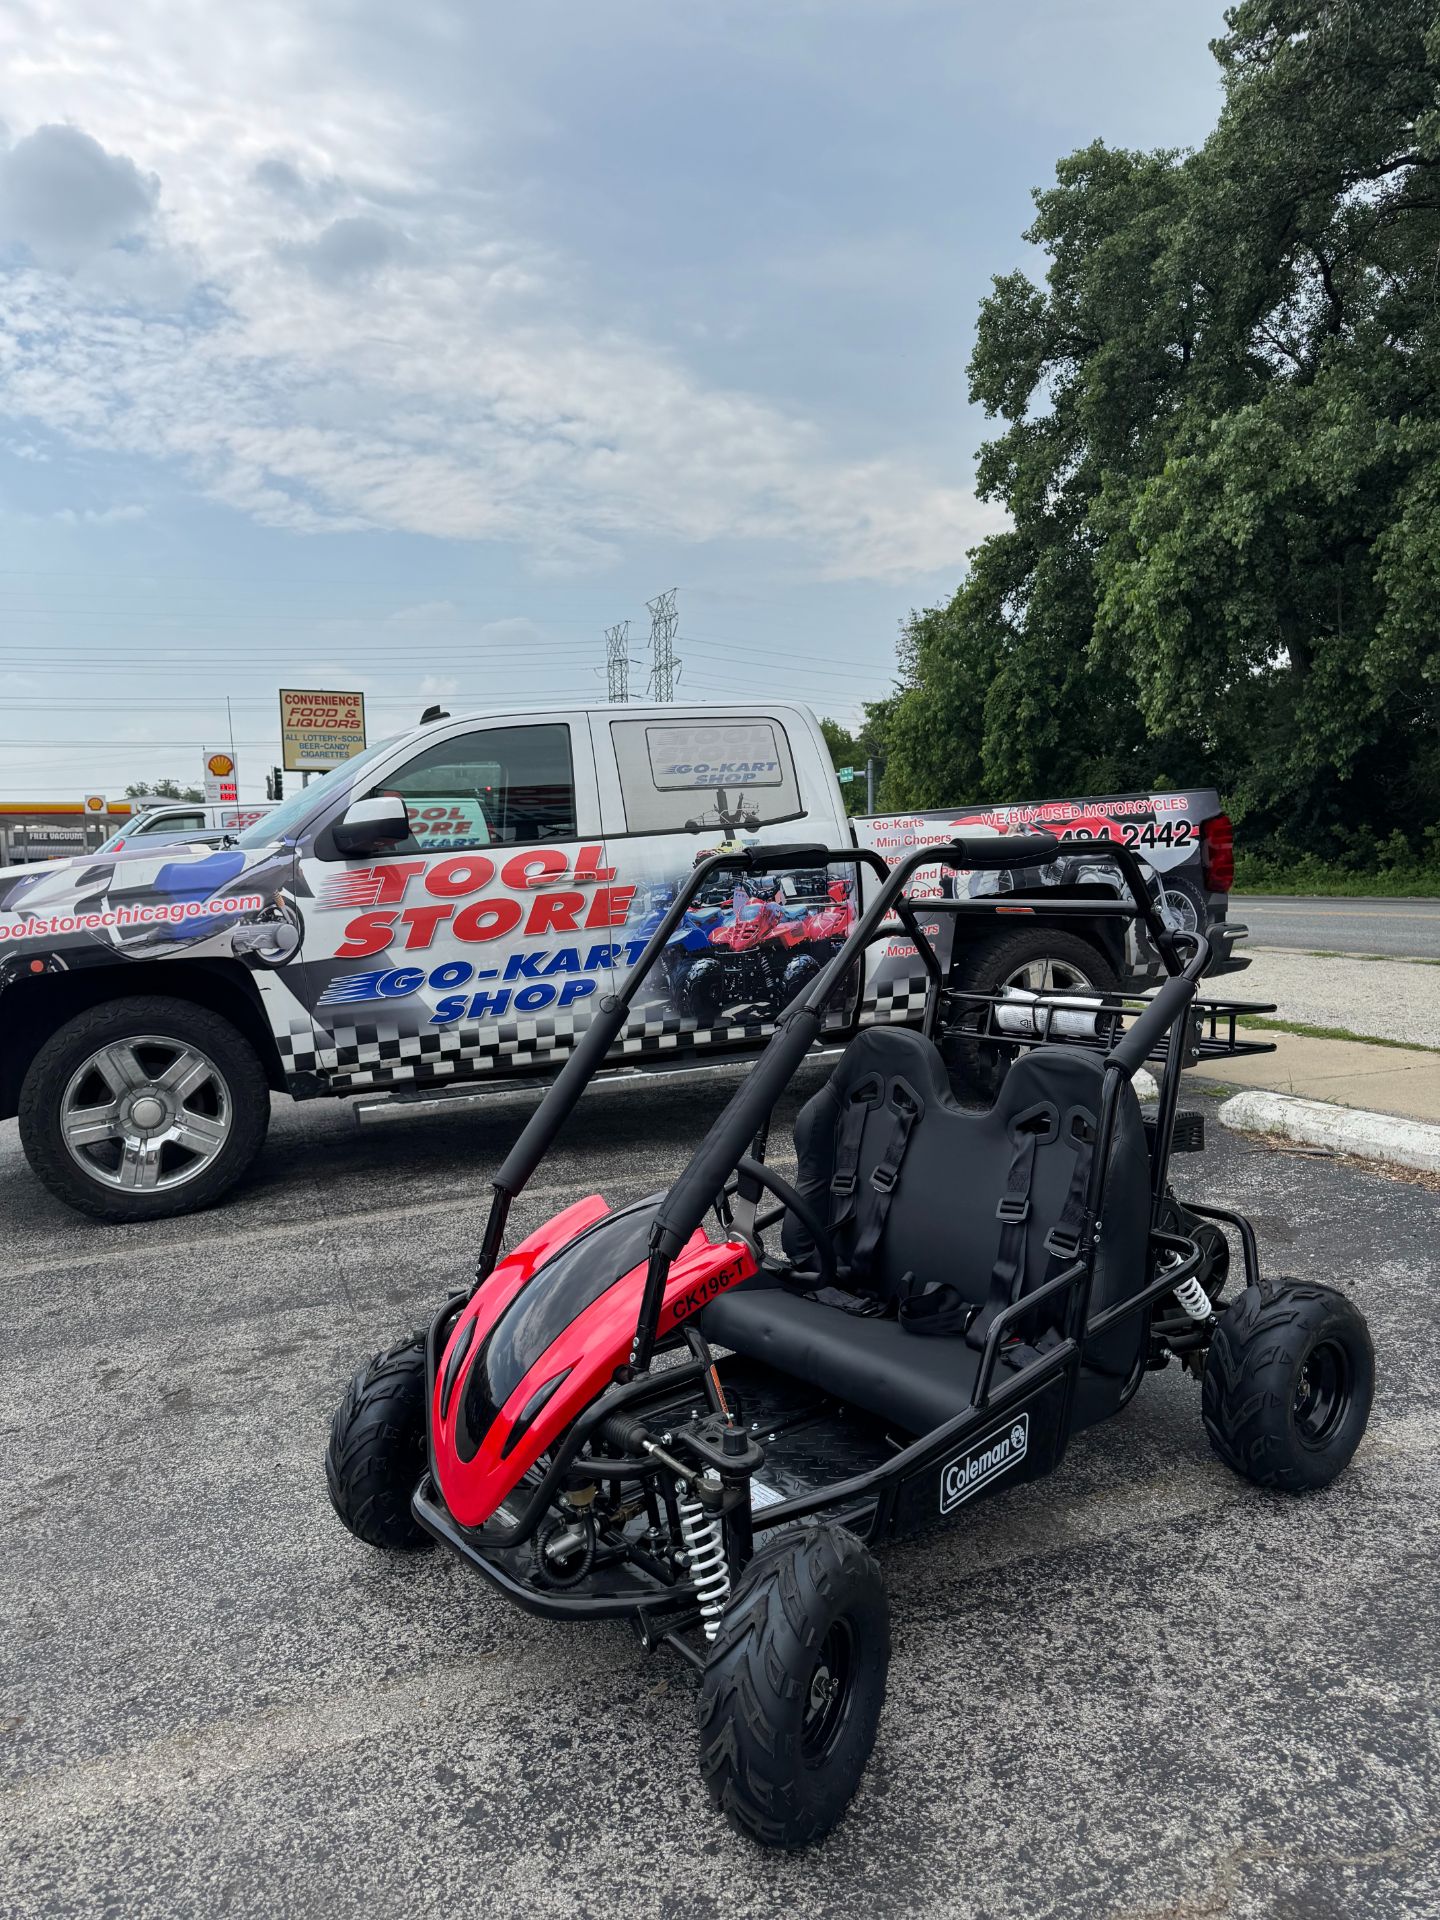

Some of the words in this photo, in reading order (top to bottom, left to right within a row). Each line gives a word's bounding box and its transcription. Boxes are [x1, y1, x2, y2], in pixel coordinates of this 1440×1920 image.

[284, 694, 361, 707] CONVENIENCE
[289, 707, 339, 718] FOOD
[344, 709, 357, 719] &
[286, 718, 362, 729] LIQUORS
[285, 734, 300, 742] ALL
[299, 742, 351, 751] BEER-CANDY
[300, 750, 350, 759] CIGARETTES
[674, 761, 778, 775] GO-KART
[694, 773, 757, 786] SHOP
[981, 812, 1005, 827] WE
[1009, 809, 1038, 824] BUY
[1042, 805, 1081, 821] USED
[1084, 798, 1189, 819] MOTORCYCLES
[872, 818, 925, 831] Go-Karts
[29, 832, 48, 841] FREE
[876, 836, 901, 848] Mini
[904, 833, 953, 847] Chopers
[1121, 819, 1193, 850] 2442
[368, 845, 617, 906] TOOL
[915, 868, 937, 881] and
[911, 886, 944, 899] Carts
[333, 885, 637, 960] STORE
[374, 939, 652, 998] GO-KART
[428, 979, 598, 1025] SHOP
[672, 1256, 744, 1319] CK196-T
[946, 1439, 1010, 1497] Coleman
